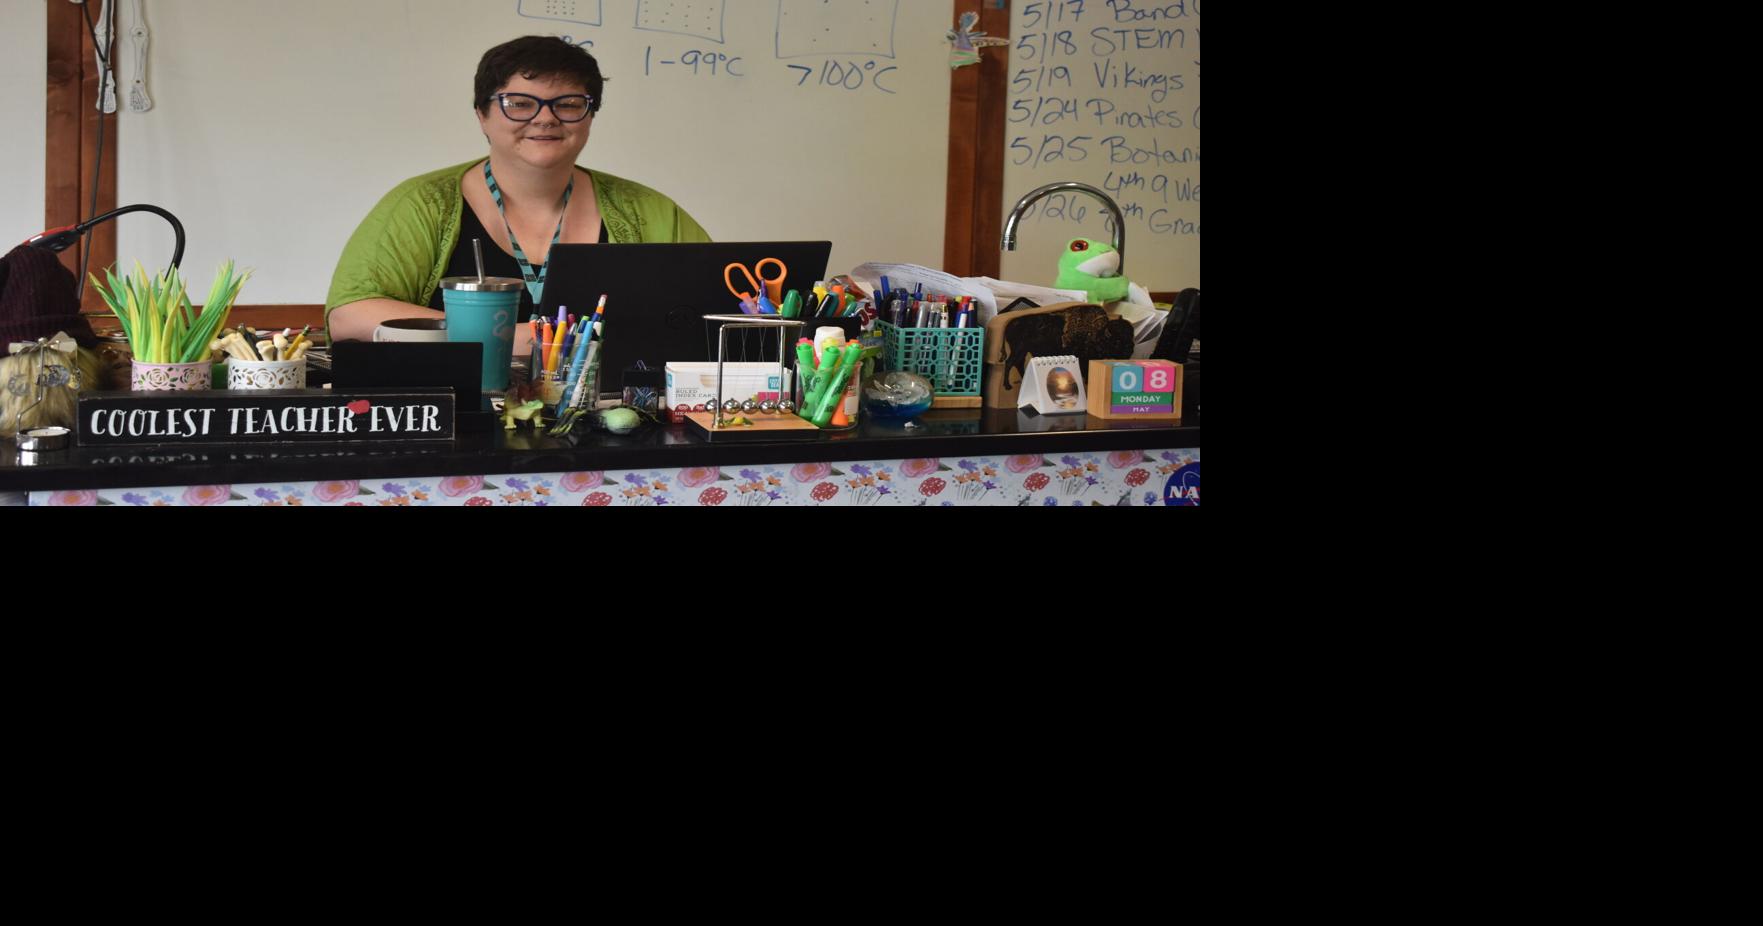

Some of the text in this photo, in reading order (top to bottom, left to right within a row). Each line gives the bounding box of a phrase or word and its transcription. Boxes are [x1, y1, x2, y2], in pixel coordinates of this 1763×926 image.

[1023, 0, 1084, 29] 5/17
[1106, 0, 1188, 23] Band
[1016, 31, 1077, 64] 5/18
[1011, 58, 1184, 103] 5/19 Vikings
[1008, 96, 1078, 127] 5/24
[1086, 98, 1182, 128] Pirates
[1010, 135, 1092, 168] 5/25
[1149, 208, 1200, 234] Gra
[1120, 395, 1161, 403] MONDAY
[90, 404, 442, 437] COOLEST TEACHER EVER
